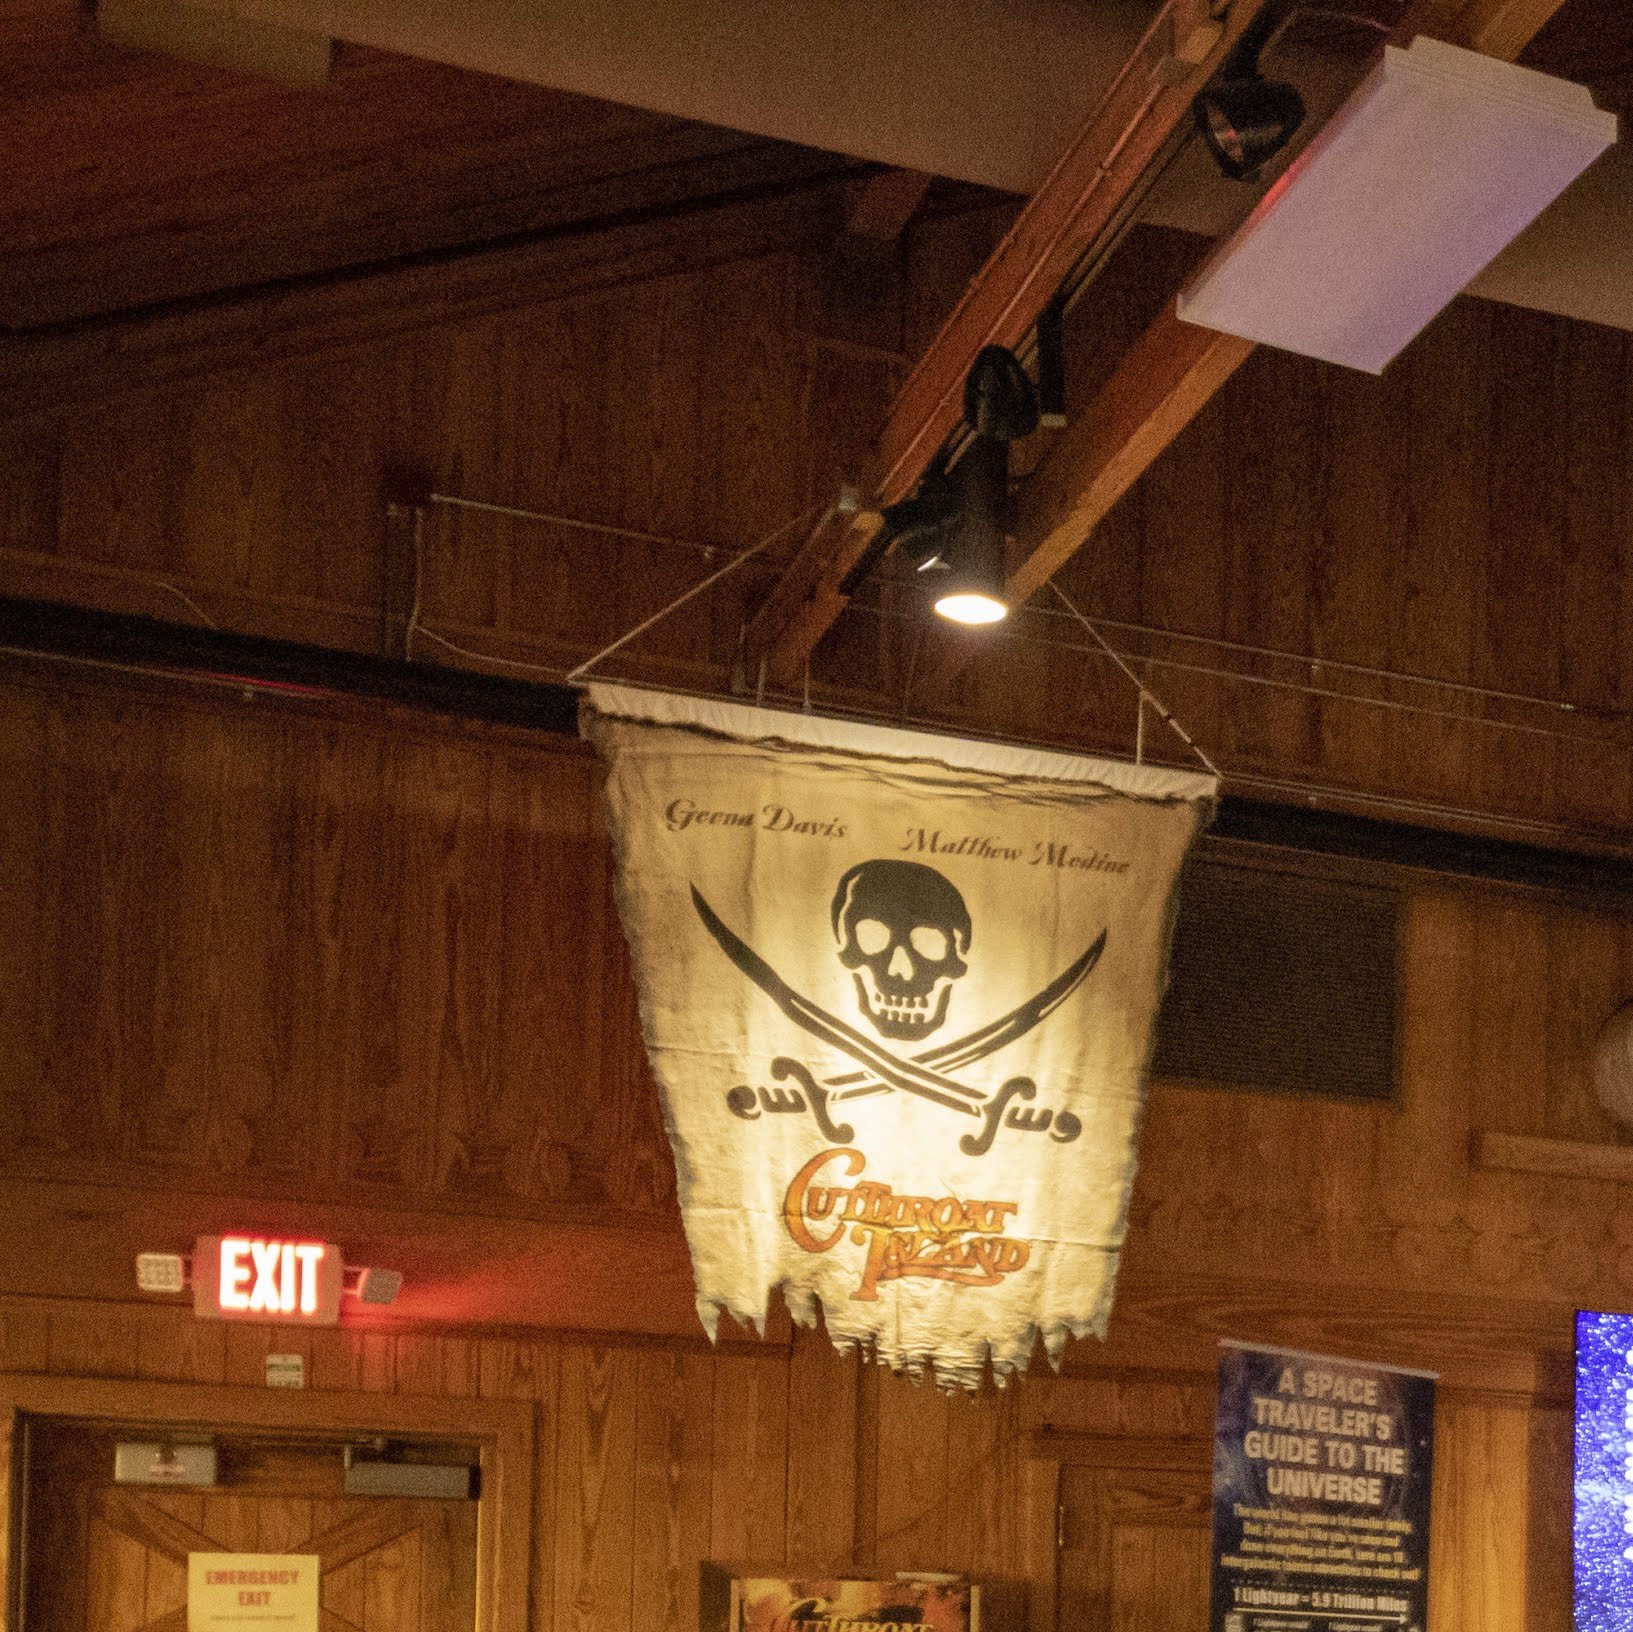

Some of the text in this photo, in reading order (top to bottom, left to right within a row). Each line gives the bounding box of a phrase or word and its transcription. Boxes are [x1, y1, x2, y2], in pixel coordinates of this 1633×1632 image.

[665, 799, 848, 838] Geena Davis
[900, 828, 1130, 874] Matthew Modine
[219, 1239, 325, 1315] EXIT
[1278, 1367, 1378, 1406] A SPACE
[1253, 1397, 1394, 1440] TRAVELER'S
[1243, 1430, 1408, 1475] GUIDE TO THE
[1266, 1467, 1383, 1505] UNIVERSE
[205, 1570, 299, 1585] EMERGENCY
[238, 1591, 272, 1606] EXIT
